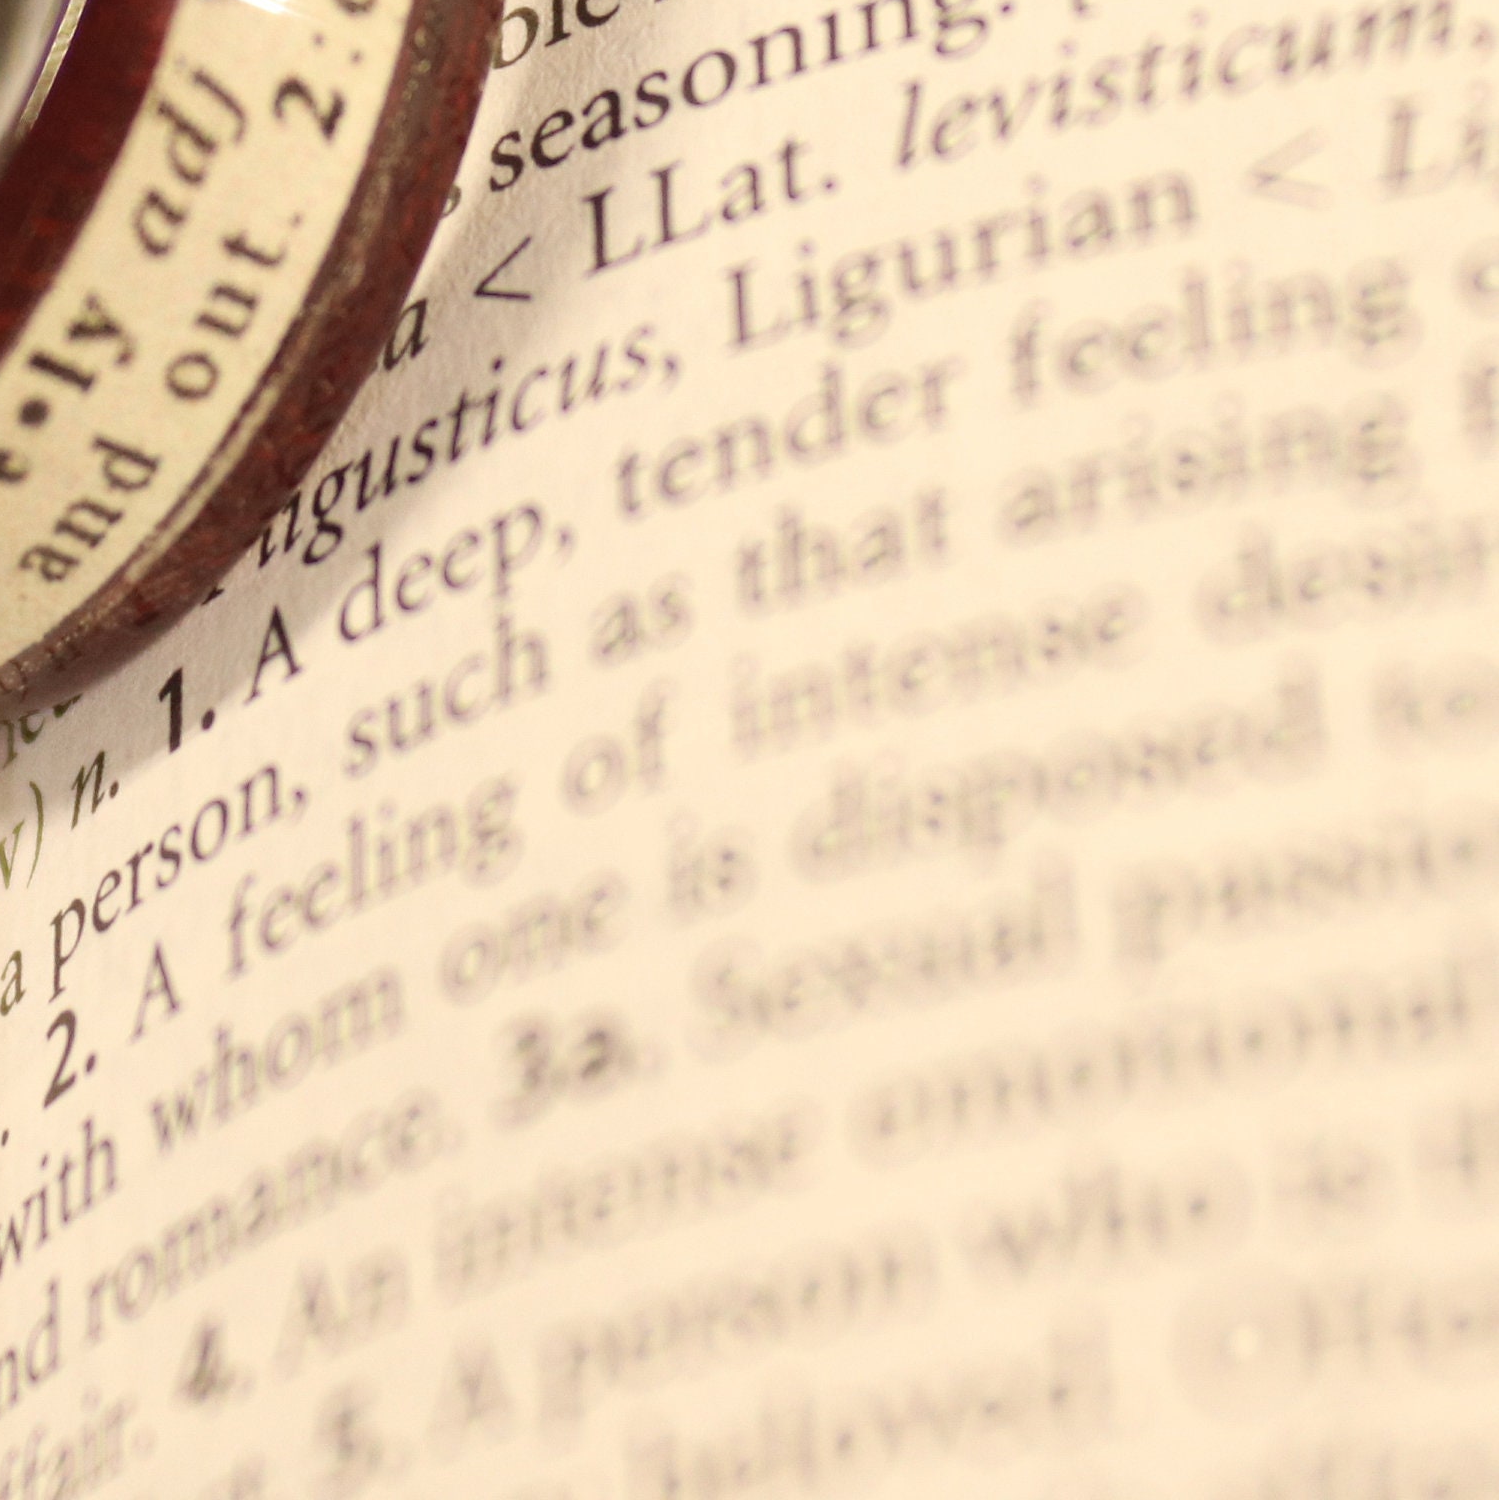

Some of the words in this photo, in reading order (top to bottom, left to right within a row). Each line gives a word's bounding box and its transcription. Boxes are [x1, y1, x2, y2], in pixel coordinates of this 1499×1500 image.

[583, 134, 837, 276] LLat.
[728, 162, 1198, 352] Ligurian
[16, 432, 161, 585] and
[157, 667, 216, 754] 1.
[247, 605, 302, 704] A
[338, 505, 576, 642] deep,
[0, 950, 26, 1017] a
[49, 762, 306, 1002] person,
[342, 614, 551, 777] such
[43, 1010, 97, 1108] 2.
[130, 941, 183, 1044] A
[225, 772, 526, 982] feeling
[560, 678, 673, 818] of
[150, 963, 405, 1156] whom
[81, 1089, 462, 1345] romance.
